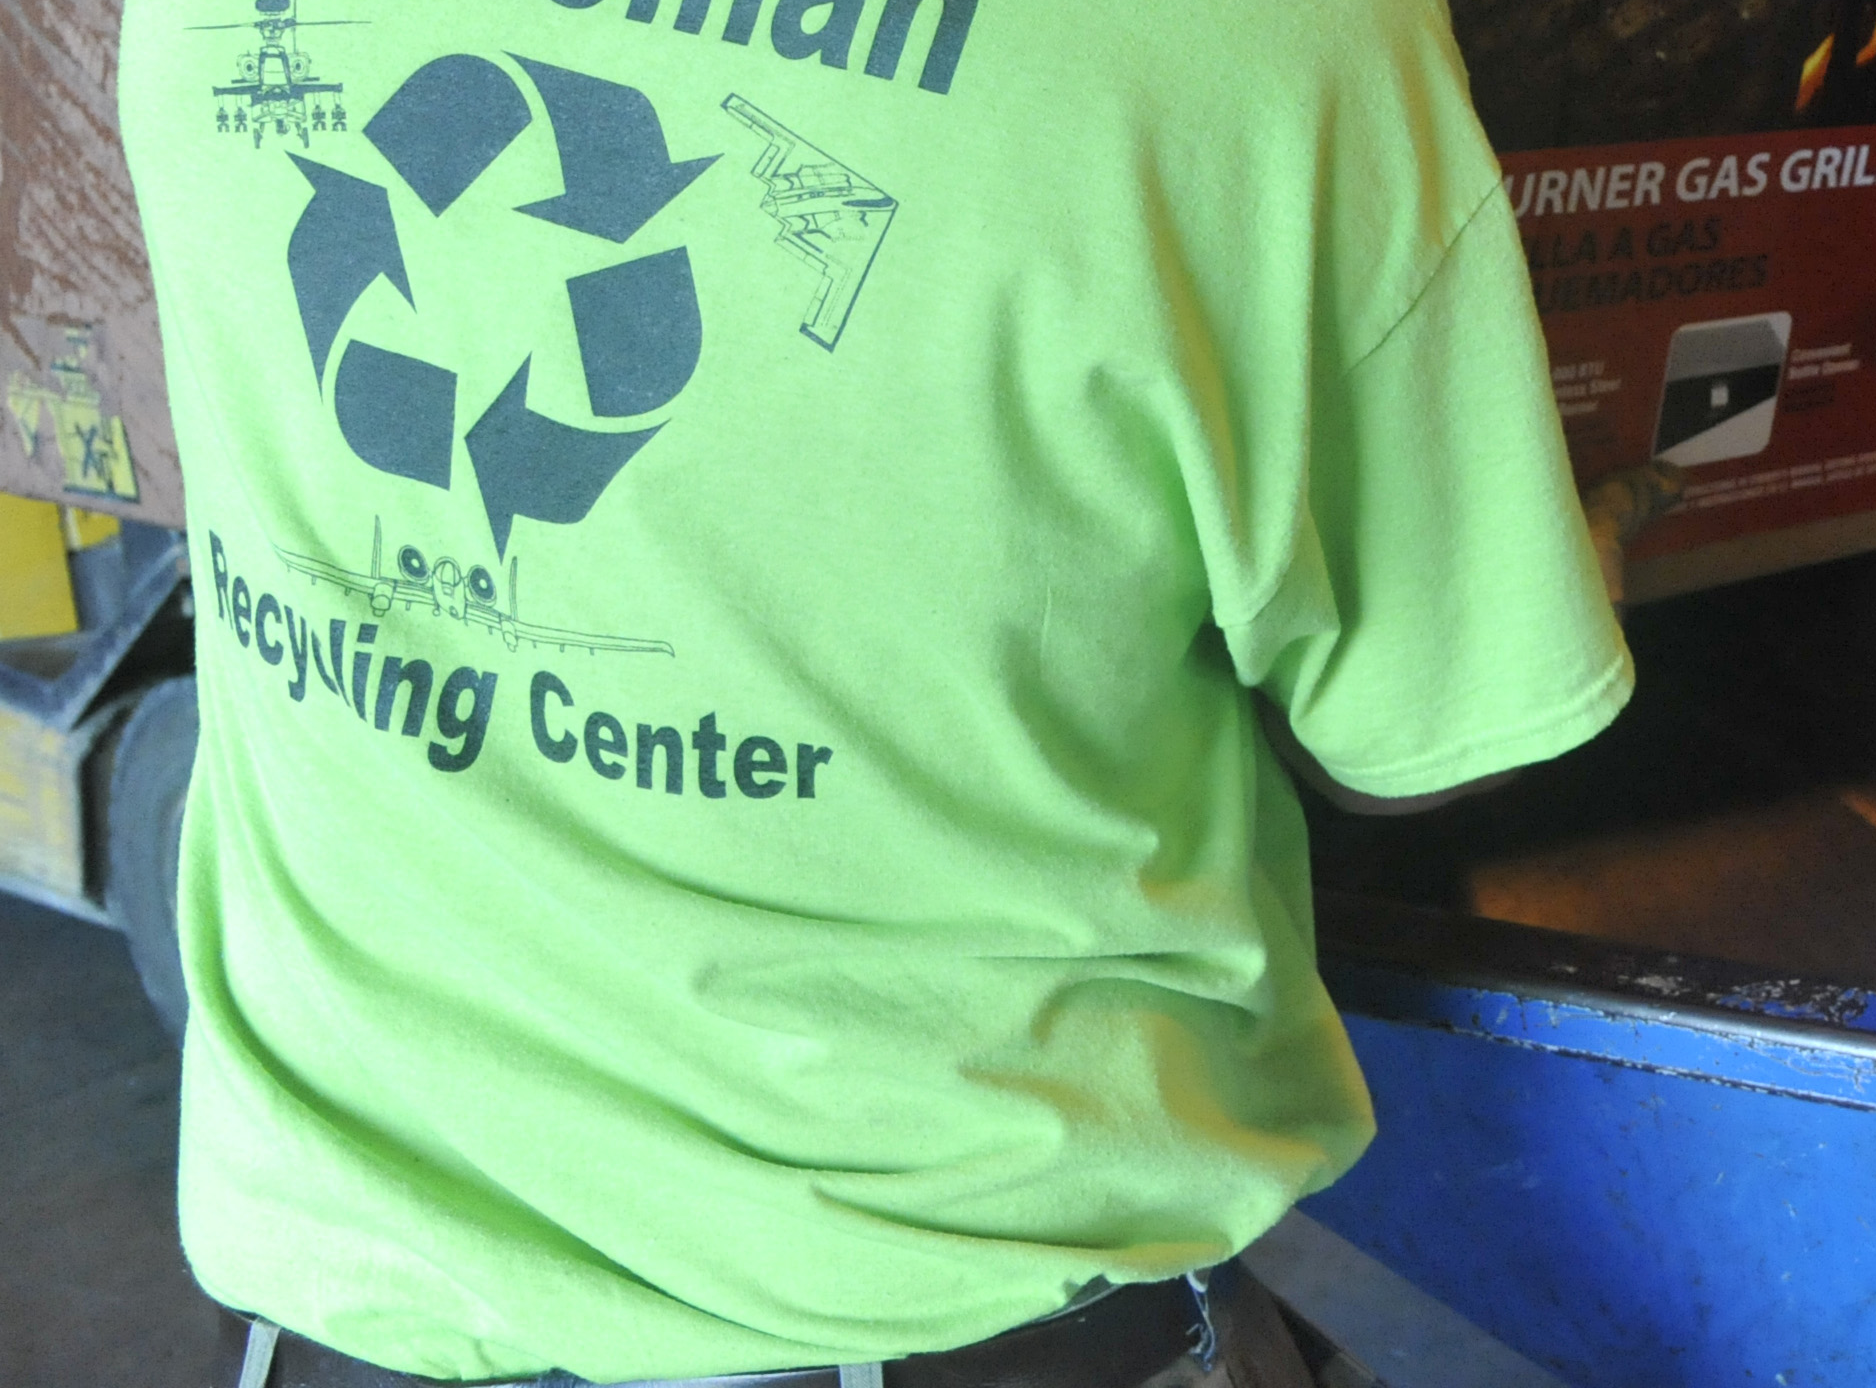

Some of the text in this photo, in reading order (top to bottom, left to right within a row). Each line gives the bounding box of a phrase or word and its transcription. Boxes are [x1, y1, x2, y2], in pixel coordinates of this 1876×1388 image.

[1676, 153, 1770, 202] GAS
[1609, 225, 1634, 262] A
[1646, 215, 1721, 258] GAS
[530, 671, 833, 800] Center
